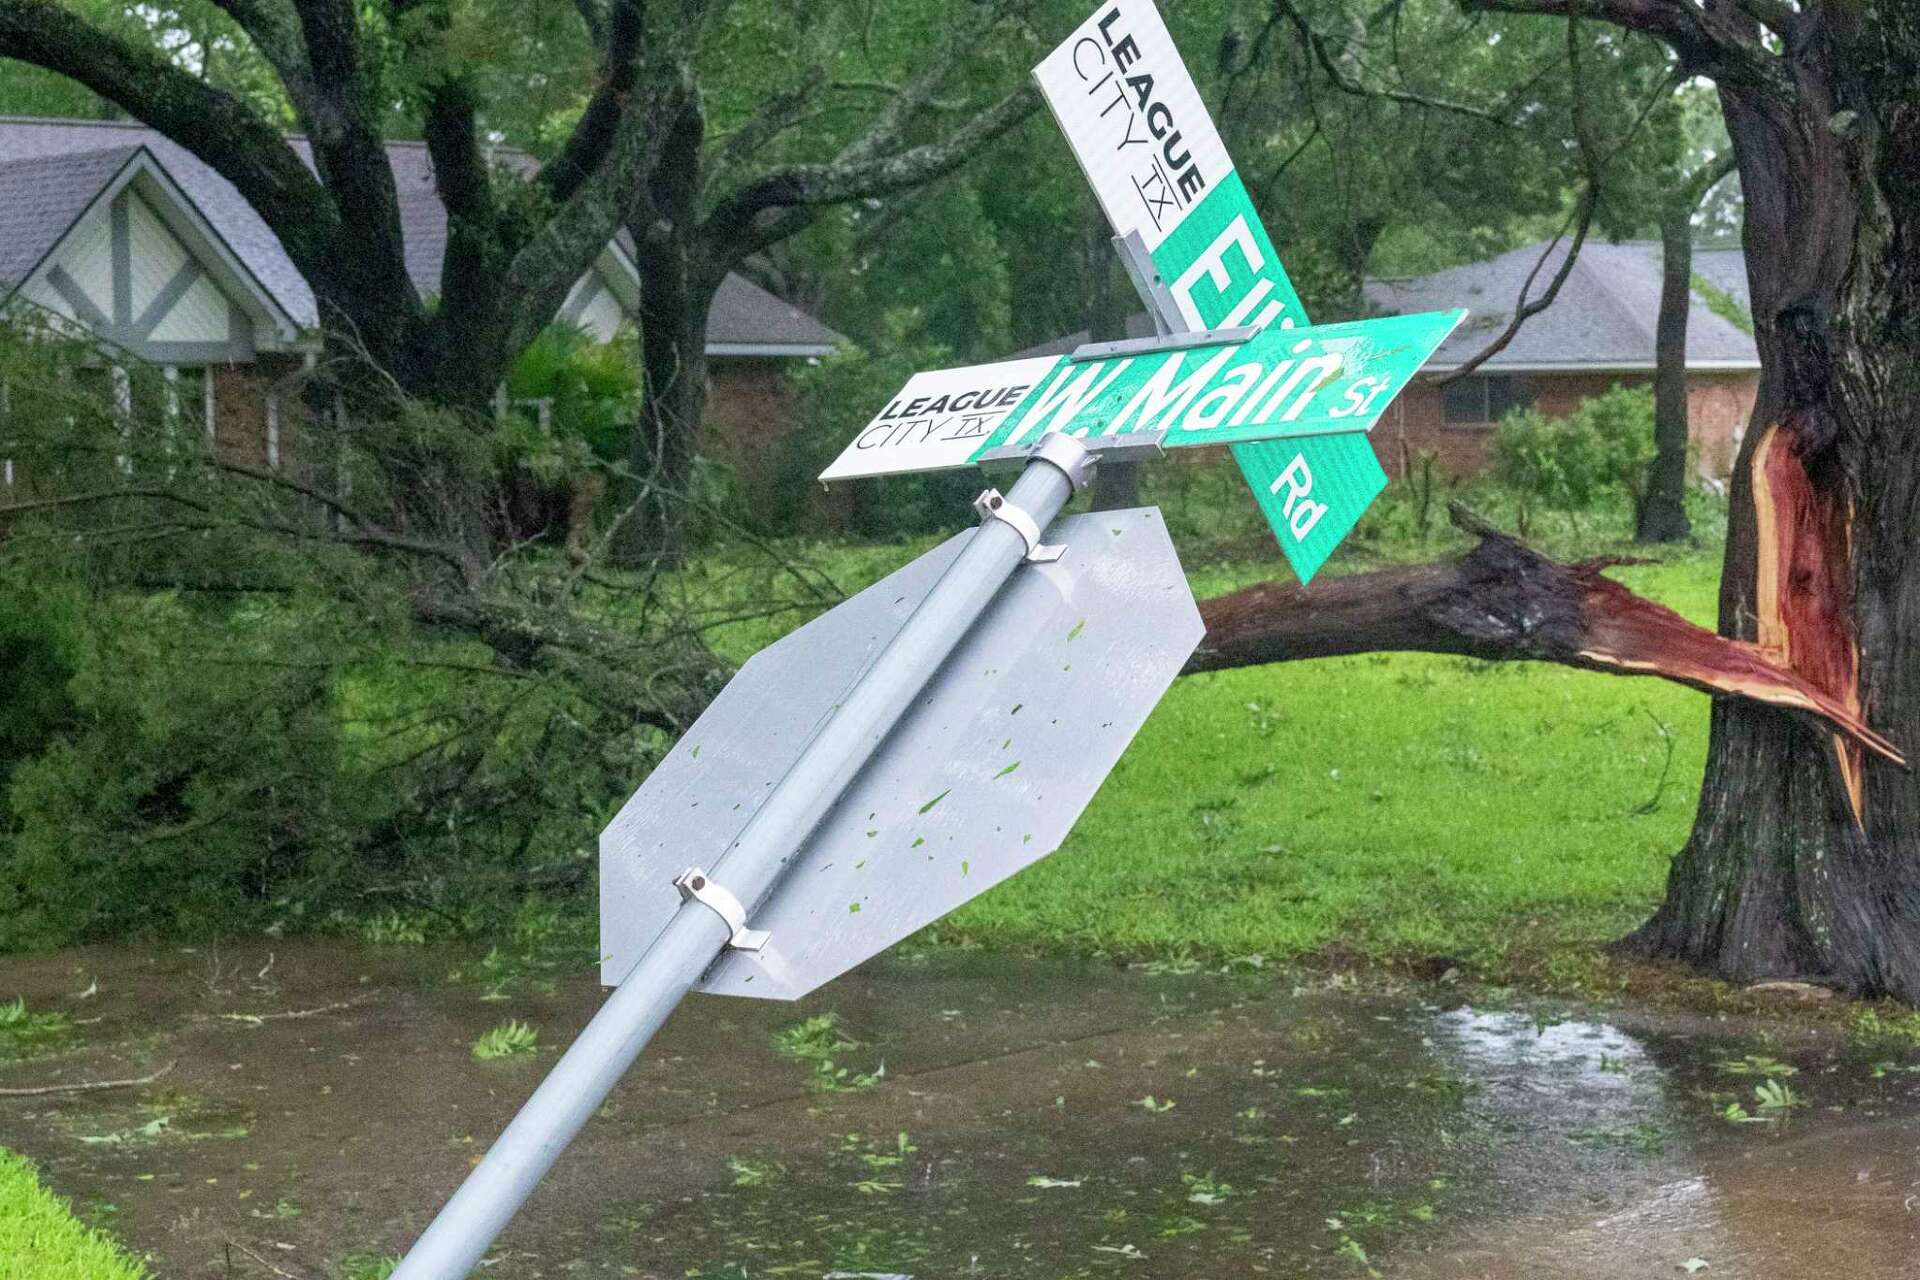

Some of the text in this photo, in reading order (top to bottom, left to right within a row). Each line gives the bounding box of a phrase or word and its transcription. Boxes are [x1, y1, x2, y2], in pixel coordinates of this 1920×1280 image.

[1073, 37, 1174, 219] CITY TX
[1098, 7, 1206, 204] LEAGUE
[856, 417, 993, 449] CITY TX
[879, 384, 1031, 420] LEAGUE
[1102, 339, 1345, 435] Main
[1330, 371, 1391, 418] St
[1270, 452, 1328, 543] Rd
